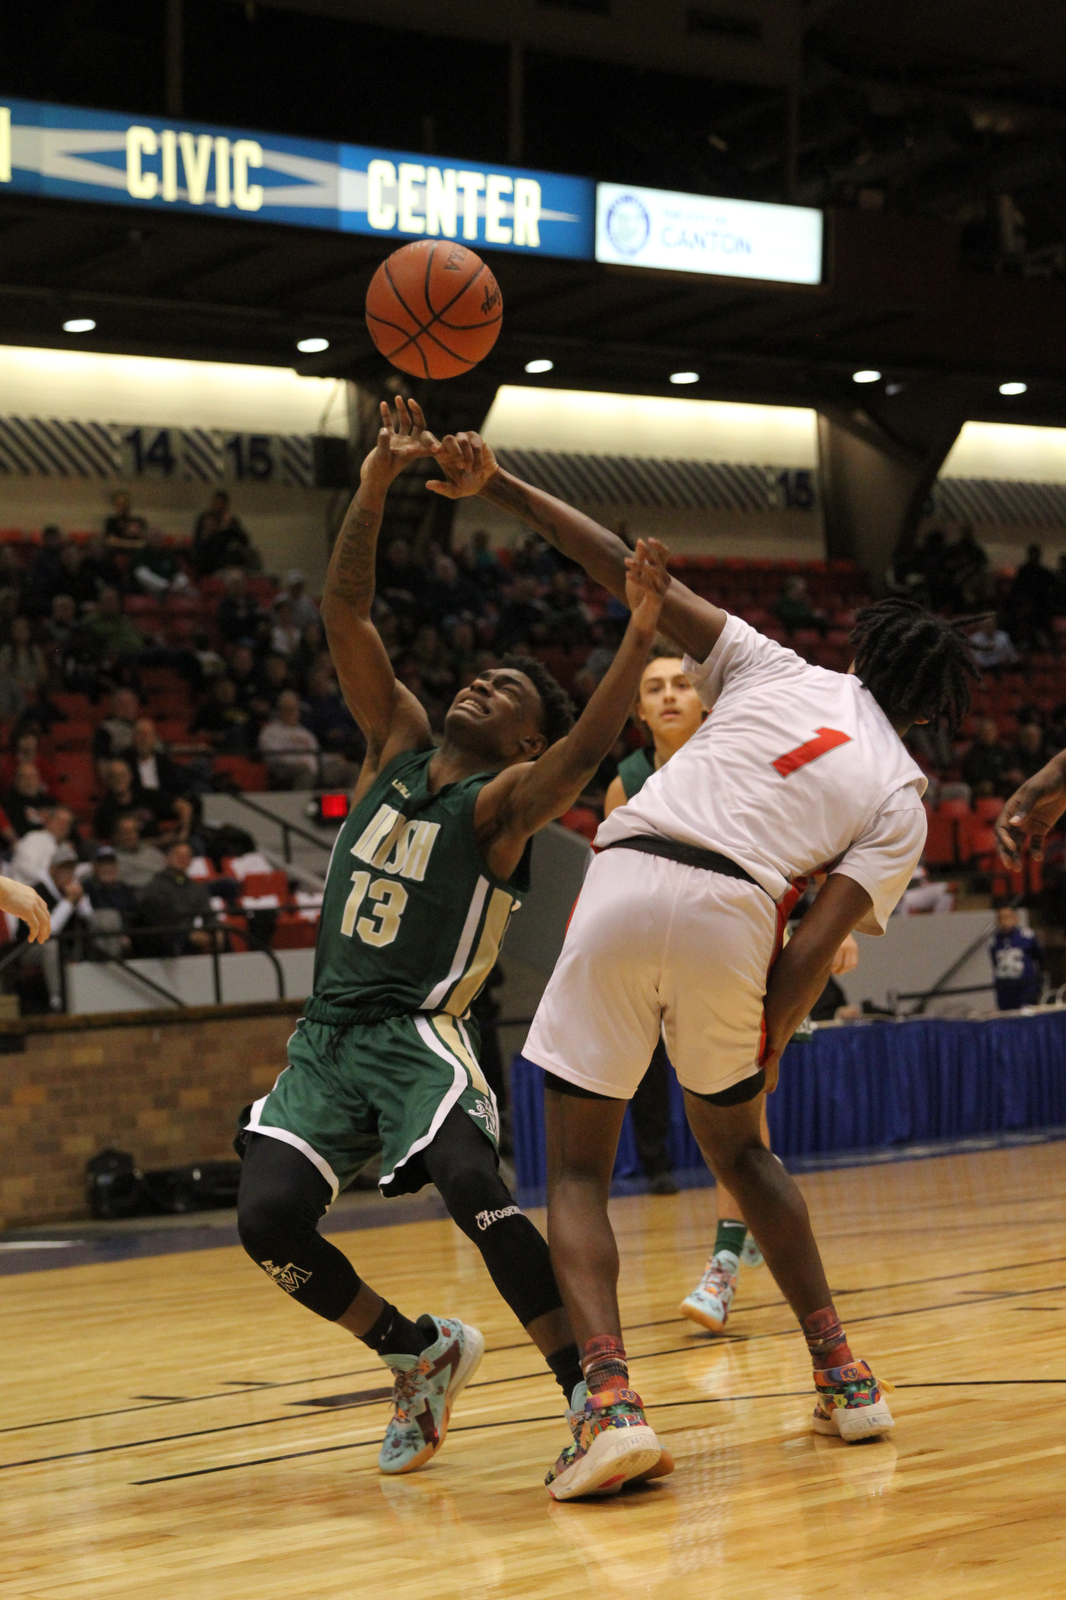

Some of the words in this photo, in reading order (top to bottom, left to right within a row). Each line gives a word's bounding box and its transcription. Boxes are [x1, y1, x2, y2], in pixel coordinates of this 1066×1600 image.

[126, 125, 264, 212] CIVIC
[367, 159, 542, 248] CENTER
[660, 224, 753, 255] CANTON
[124, 427, 177, 476] 14
[226, 434, 273, 483] 15
[768, 725, 855, 780] 1
[340, 870, 409, 948] 13
